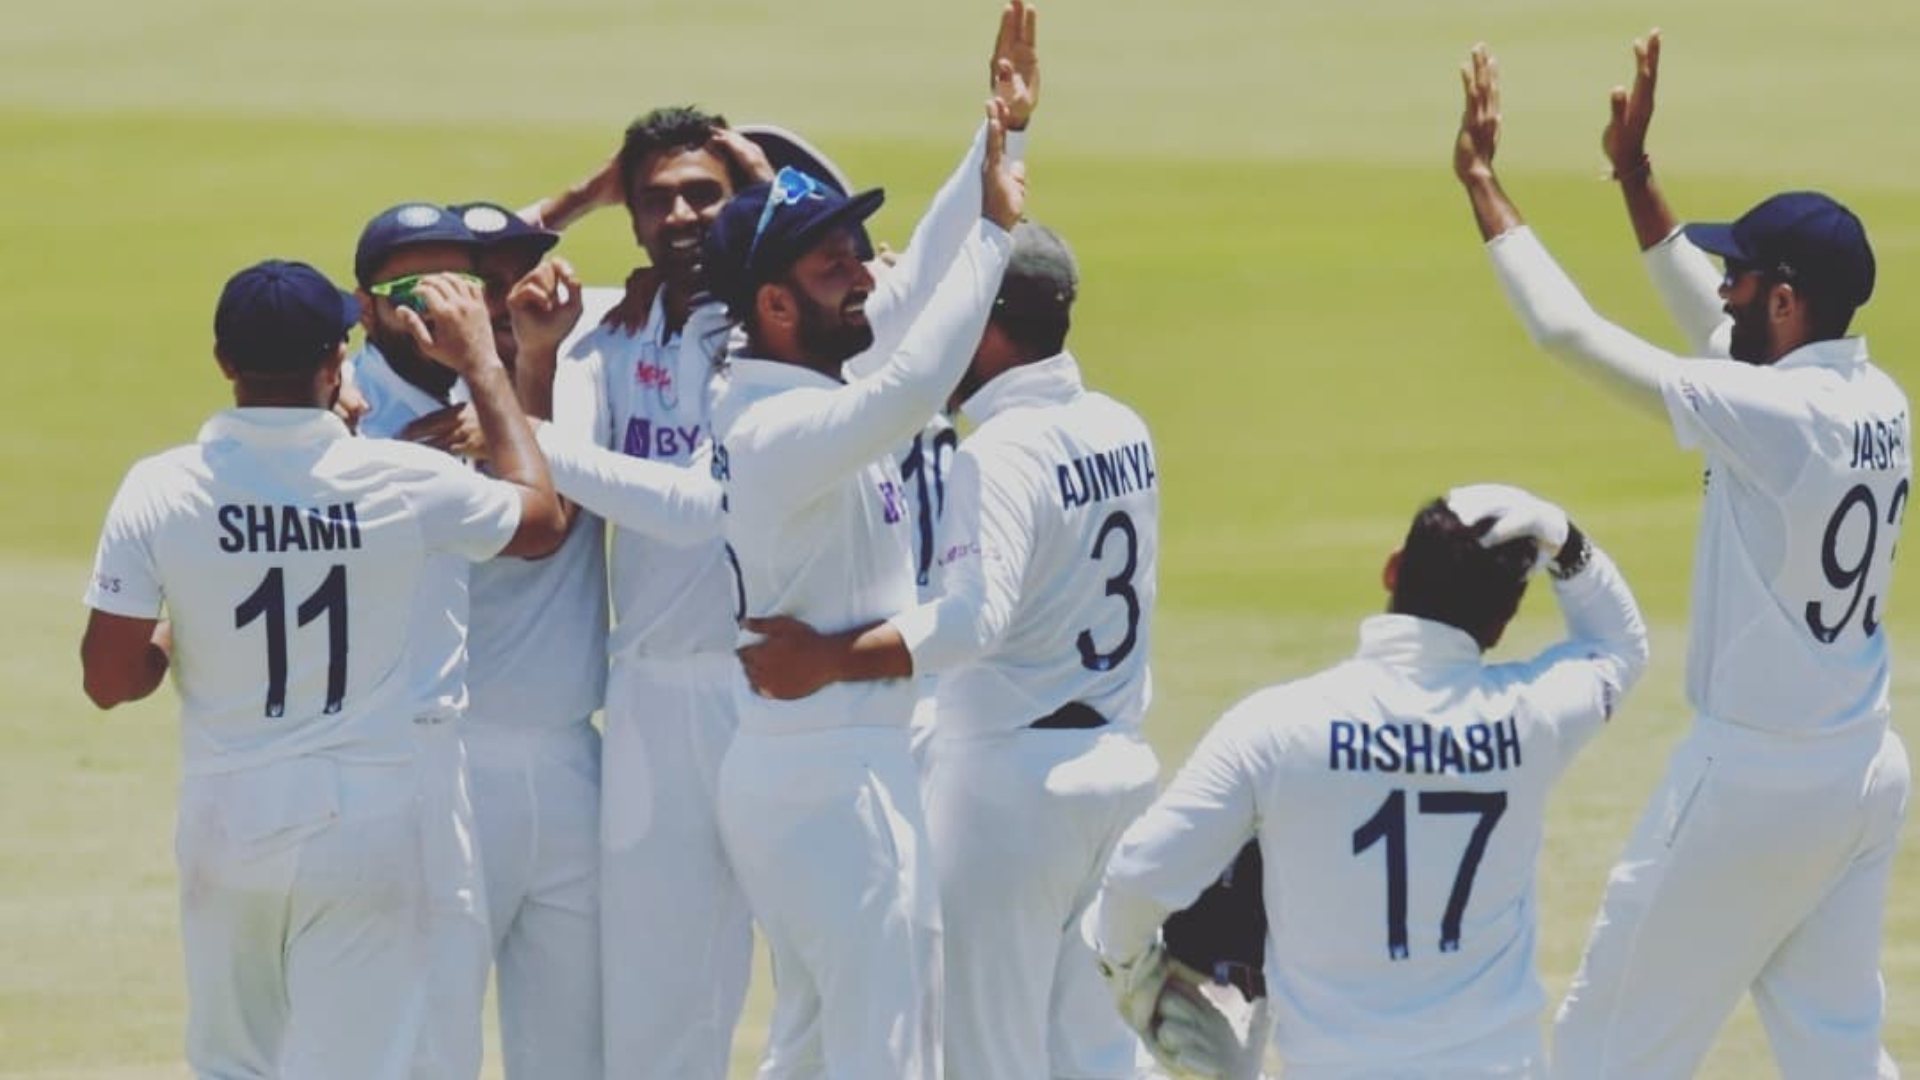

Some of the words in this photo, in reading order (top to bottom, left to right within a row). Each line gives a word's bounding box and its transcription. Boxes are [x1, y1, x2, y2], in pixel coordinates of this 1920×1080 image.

[217, 502, 362, 553] SHAMI
[1057, 441, 1155, 510] AJINKYA
[235, 564, 349, 718] 11
[1076, 510, 1140, 671] 3
[1329, 716, 1522, 775] RISHABH
[1353, 789, 1508, 961] 17
